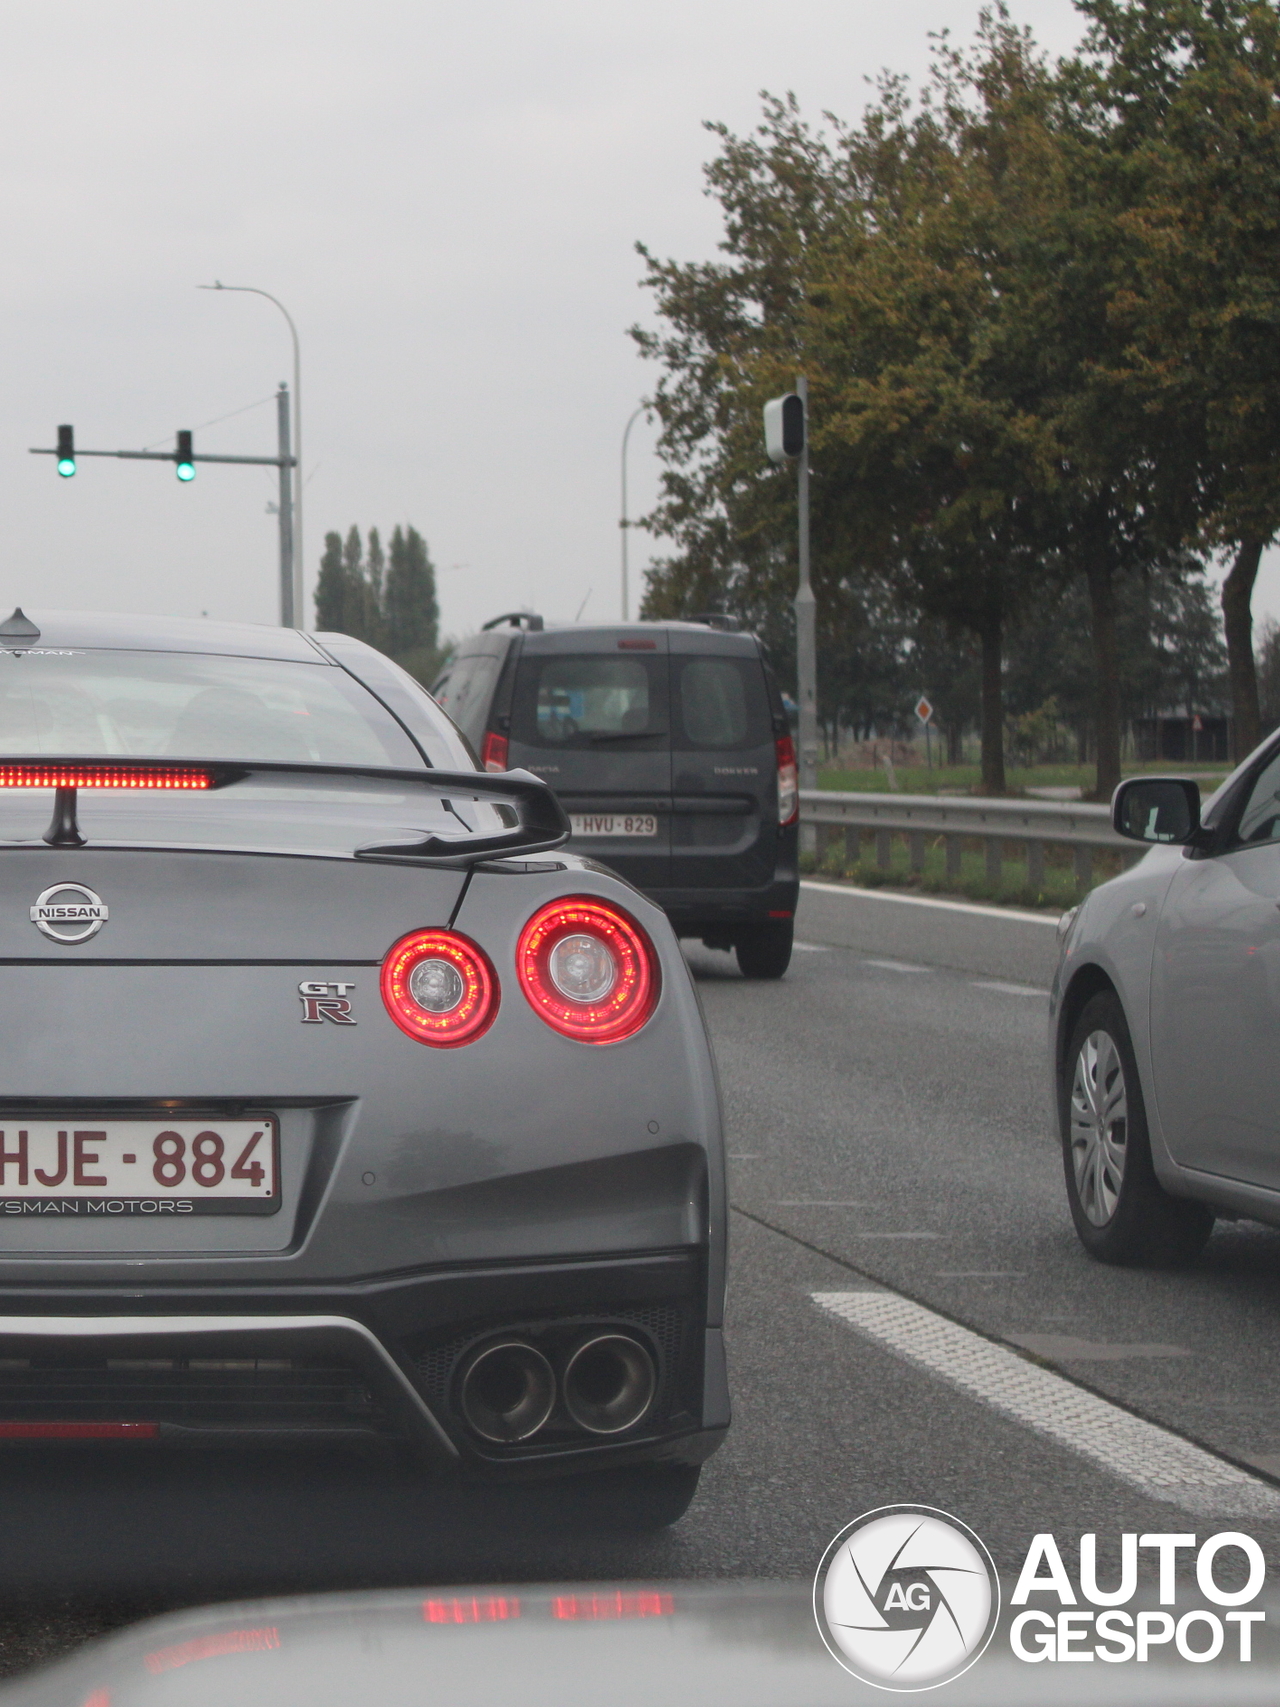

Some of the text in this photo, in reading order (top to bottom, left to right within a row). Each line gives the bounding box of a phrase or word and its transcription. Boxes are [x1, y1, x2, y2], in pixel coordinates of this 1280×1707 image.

[38, 907, 101, 918] NISSAN
[298, 981, 356, 997] GT
[299, 997, 357, 1026] R
[86, 1200, 194, 1214] MOTORS
